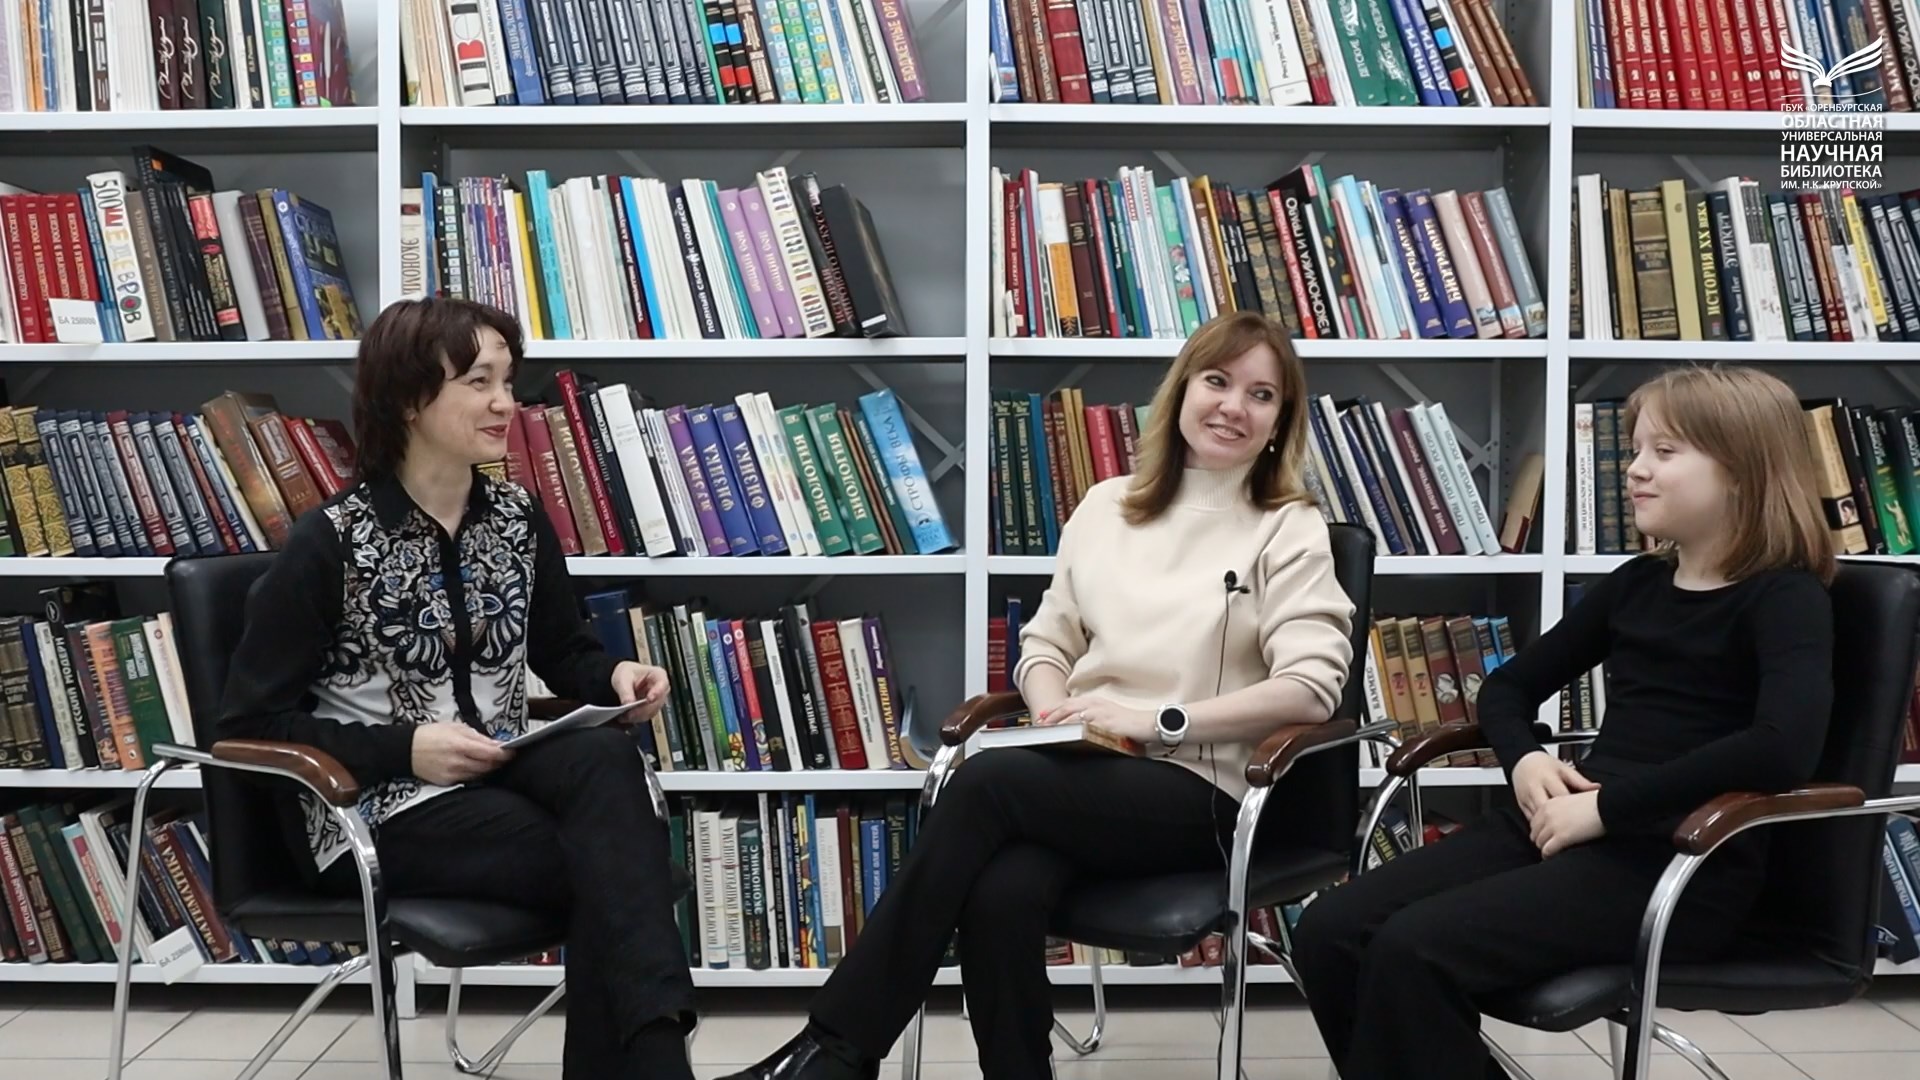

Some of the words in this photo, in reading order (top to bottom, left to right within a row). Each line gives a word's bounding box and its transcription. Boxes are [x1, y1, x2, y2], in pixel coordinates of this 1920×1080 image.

[1267, 6, 1279, 40] Windows
[887, 20, 917, 82] БЮДЖЕТНЫЕ
[1350, 39, 1369, 77] ДЕТСКИЕ
[93, 179, 123, 208] 500
[1285, 197, 1303, 236] ПРАВО
[1696, 201, 1708, 228] ВЕКА
[675, 197, 693, 245] КОДЕКСОВ
[1297, 238, 1308, 248] И
[1698, 231, 1712, 249] XX
[1717, 212, 1738, 268] ЭТИКЕТ
[104, 208, 141, 323] ШЕДЕВРОВ
[1300, 250, 1329, 328] ЭКОНОМИКА
[1700, 252, 1721, 315] ИСТОРИЯ
[699, 292, 715, 332] ПОЛНЫЙ
[821, 268, 845, 323] ИСТОРИЯ
[883, 416, 902, 448] ВЕКА
[1424, 432, 1441, 461] РОССИИ
[1445, 430, 1460, 459] РОССИИ
[681, 444, 712, 511] МУЗЫКА
[703, 443, 735, 510] ФИЗИКА
[733, 441, 766, 508] ФИЗИКА
[792, 433, 833, 522] БИОЛОГИЯ
[827, 432, 867, 520] БИОЛОГИЯ
[897, 453, 924, 510] СТРОФЫ
[1438, 465, 1455, 499] ГОРОДОВ
[1458, 463, 1475, 497] ГОРОДОВ
[1453, 502, 1465, 526] ГЕРБЫ
[1473, 500, 1486, 524] ГЕРБЫ
[55, 637, 74, 684] МОДЕРН
[70, 687, 86, 735] РУССКИЙ
[802, 693, 819, 735] ЭРМИТАЖ
[876, 677, 894, 724] ПЛЕТЕНИЯ
[863, 717, 873, 742] НОВЫЙ
[888, 726, 901, 763] АЗБУКА
[721, 826, 738, 910] ИМПРЕССИОНИЗМА
[741, 844, 752, 915] ПРИНЦИПЫ
[749, 844, 763, 914] ЭКОНОМИКС
[162, 845, 217, 951] МАТЕМАТИКА
[727, 913, 741, 952] ИСТОРИЯ
